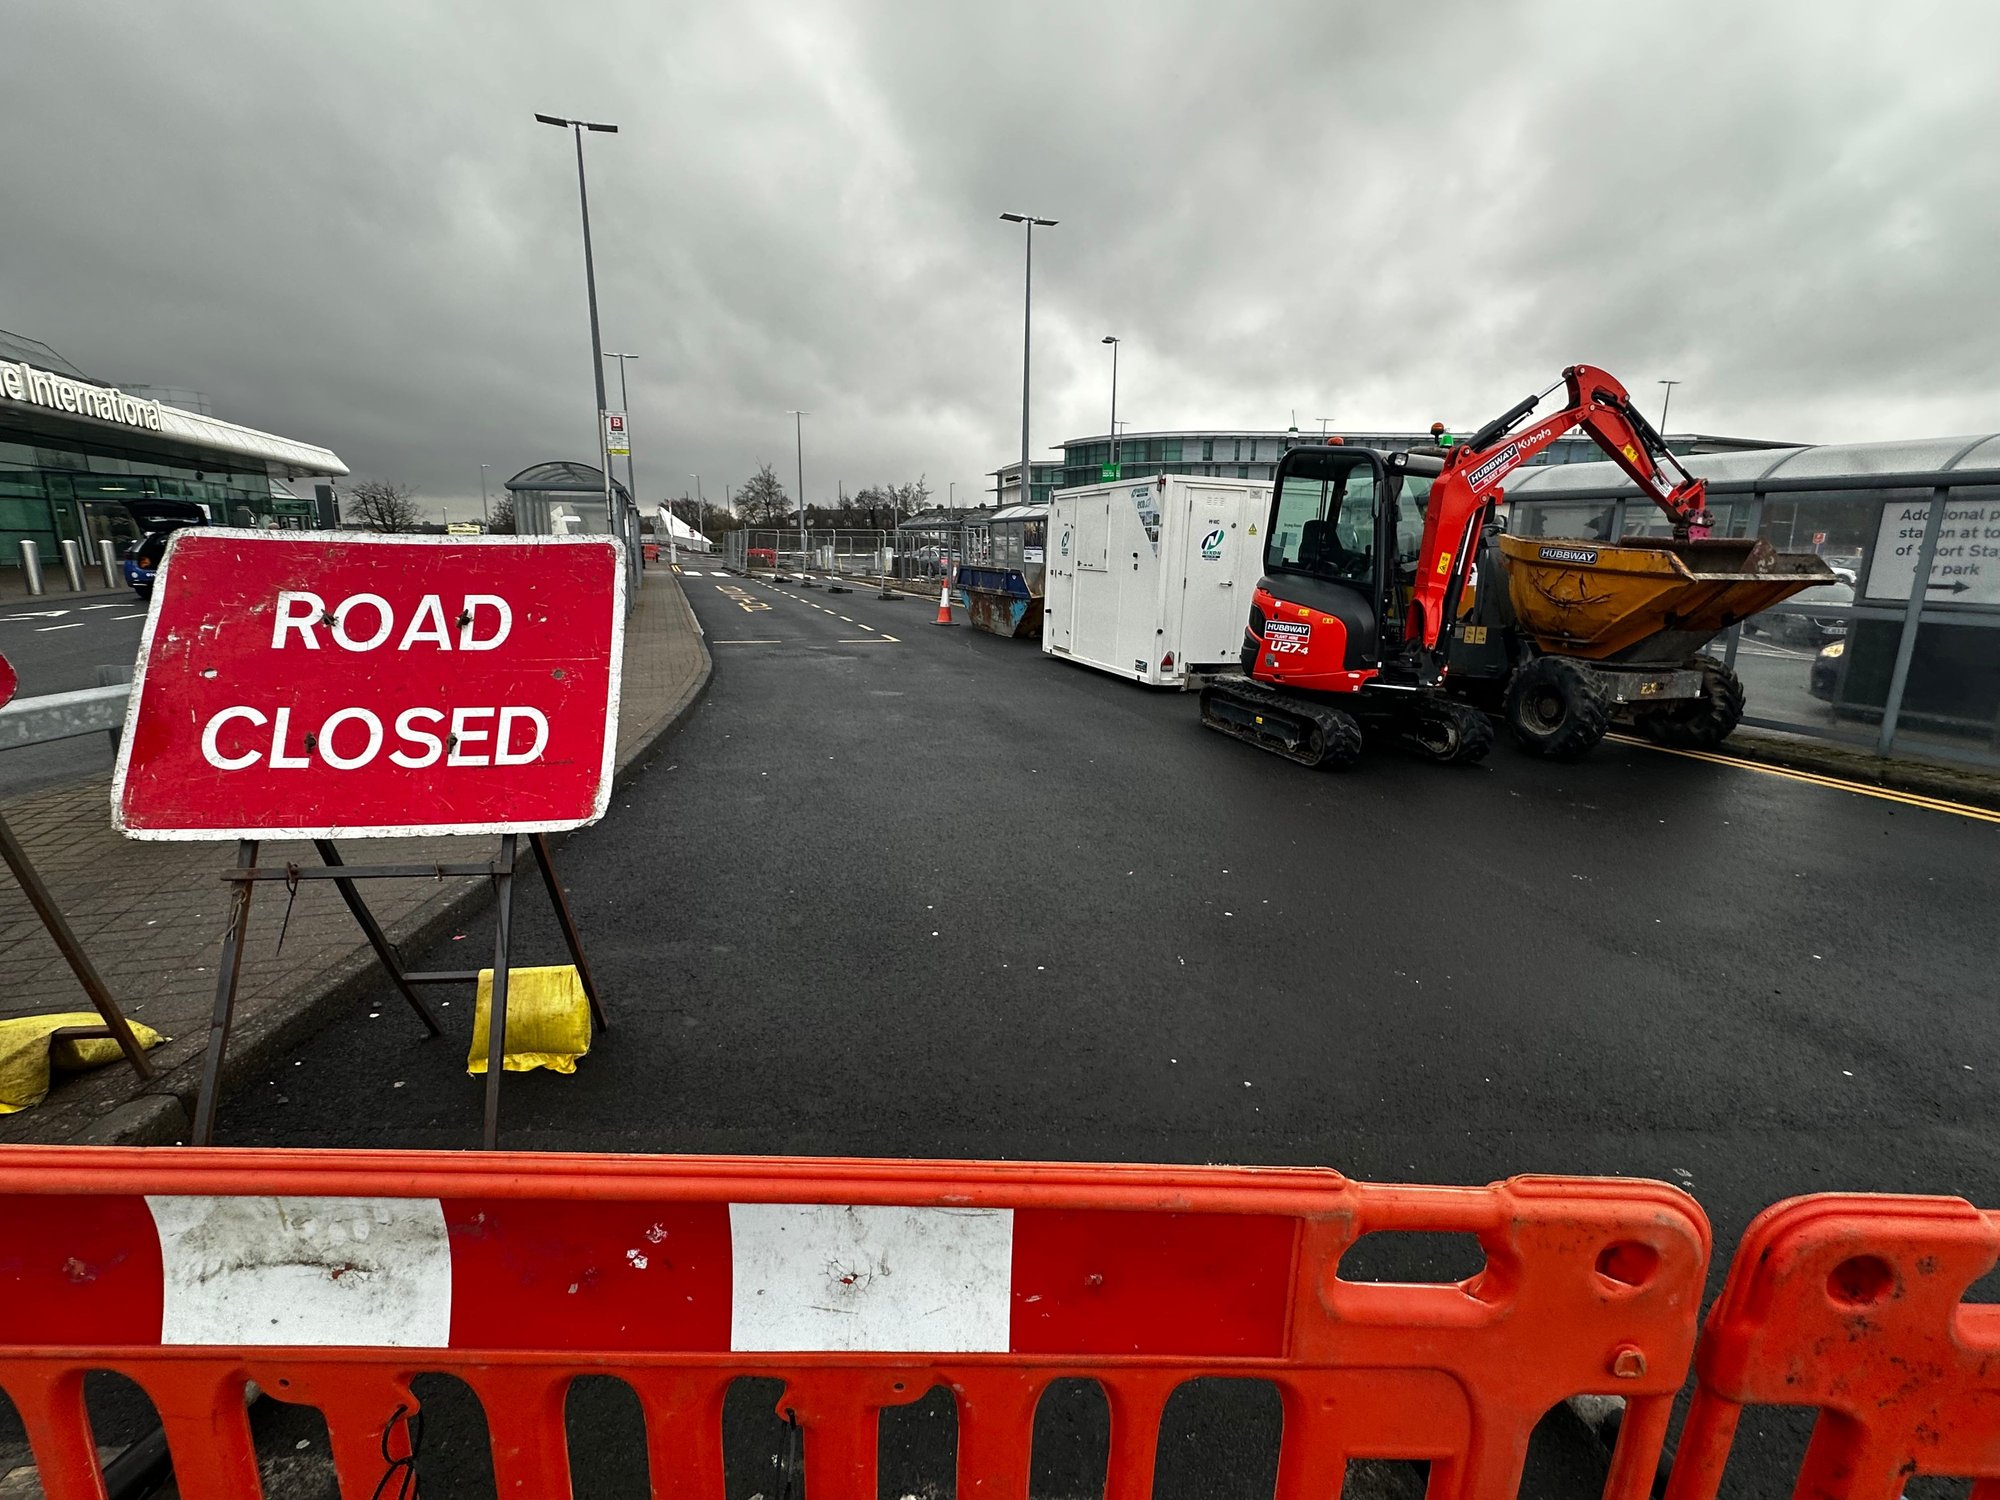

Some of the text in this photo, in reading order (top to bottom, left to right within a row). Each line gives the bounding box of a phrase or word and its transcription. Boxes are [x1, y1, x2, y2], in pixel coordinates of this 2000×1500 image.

[20, 363, 164, 431] International
[612, 418, 621, 427] B
[1517, 428, 1552, 449] Kubota
[1471, 447, 1514, 484] HUBBWAY
[1900, 509, 1984, 521] Addional
[1899, 526, 1955, 539] staon
[1960, 526, 1979, 539] at
[1542, 548, 1595, 561] HUBBWAY
[1895, 544, 1913, 556] of
[1969, 545, 2000, 560] Sta
[1912, 562, 1980, 576] cr park
[271, 591, 512, 652] ROAD
[1267, 623, 1308, 634] HUBBWAY
[1270, 640, 1309, 655] U27-4
[201, 705, 550, 770] CLOSED
